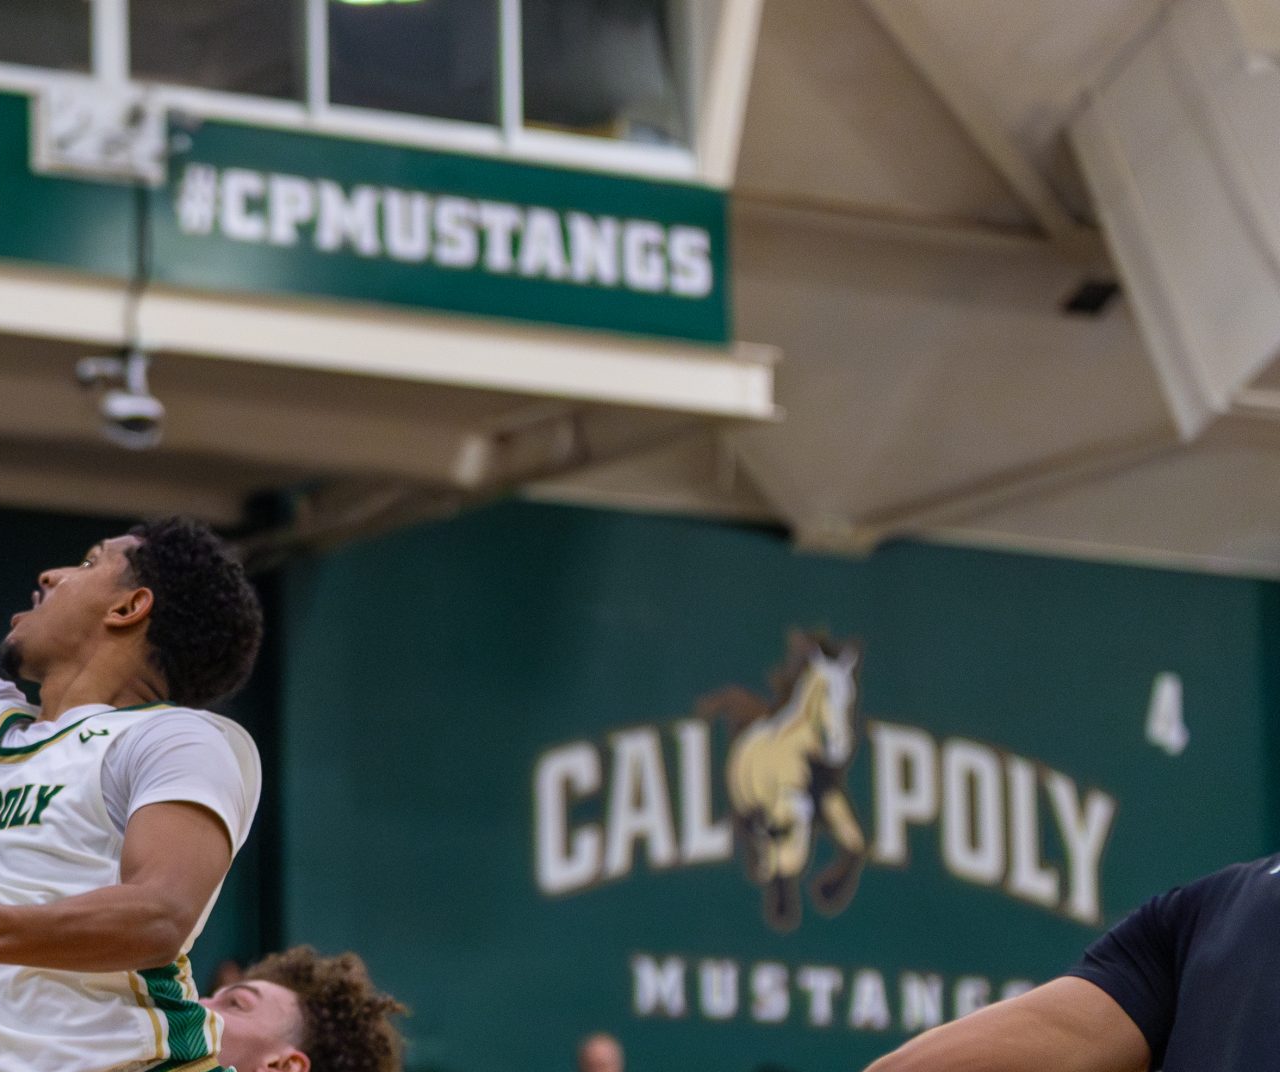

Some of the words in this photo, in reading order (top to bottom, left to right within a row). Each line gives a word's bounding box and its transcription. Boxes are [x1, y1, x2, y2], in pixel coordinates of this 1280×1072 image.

[177, 162, 715, 299] #CPMUSTANGS
[532, 717, 734, 897] CAL
[866, 718, 1118, 926] POLY
[630, 951, 1034, 1032] MUSTANG
